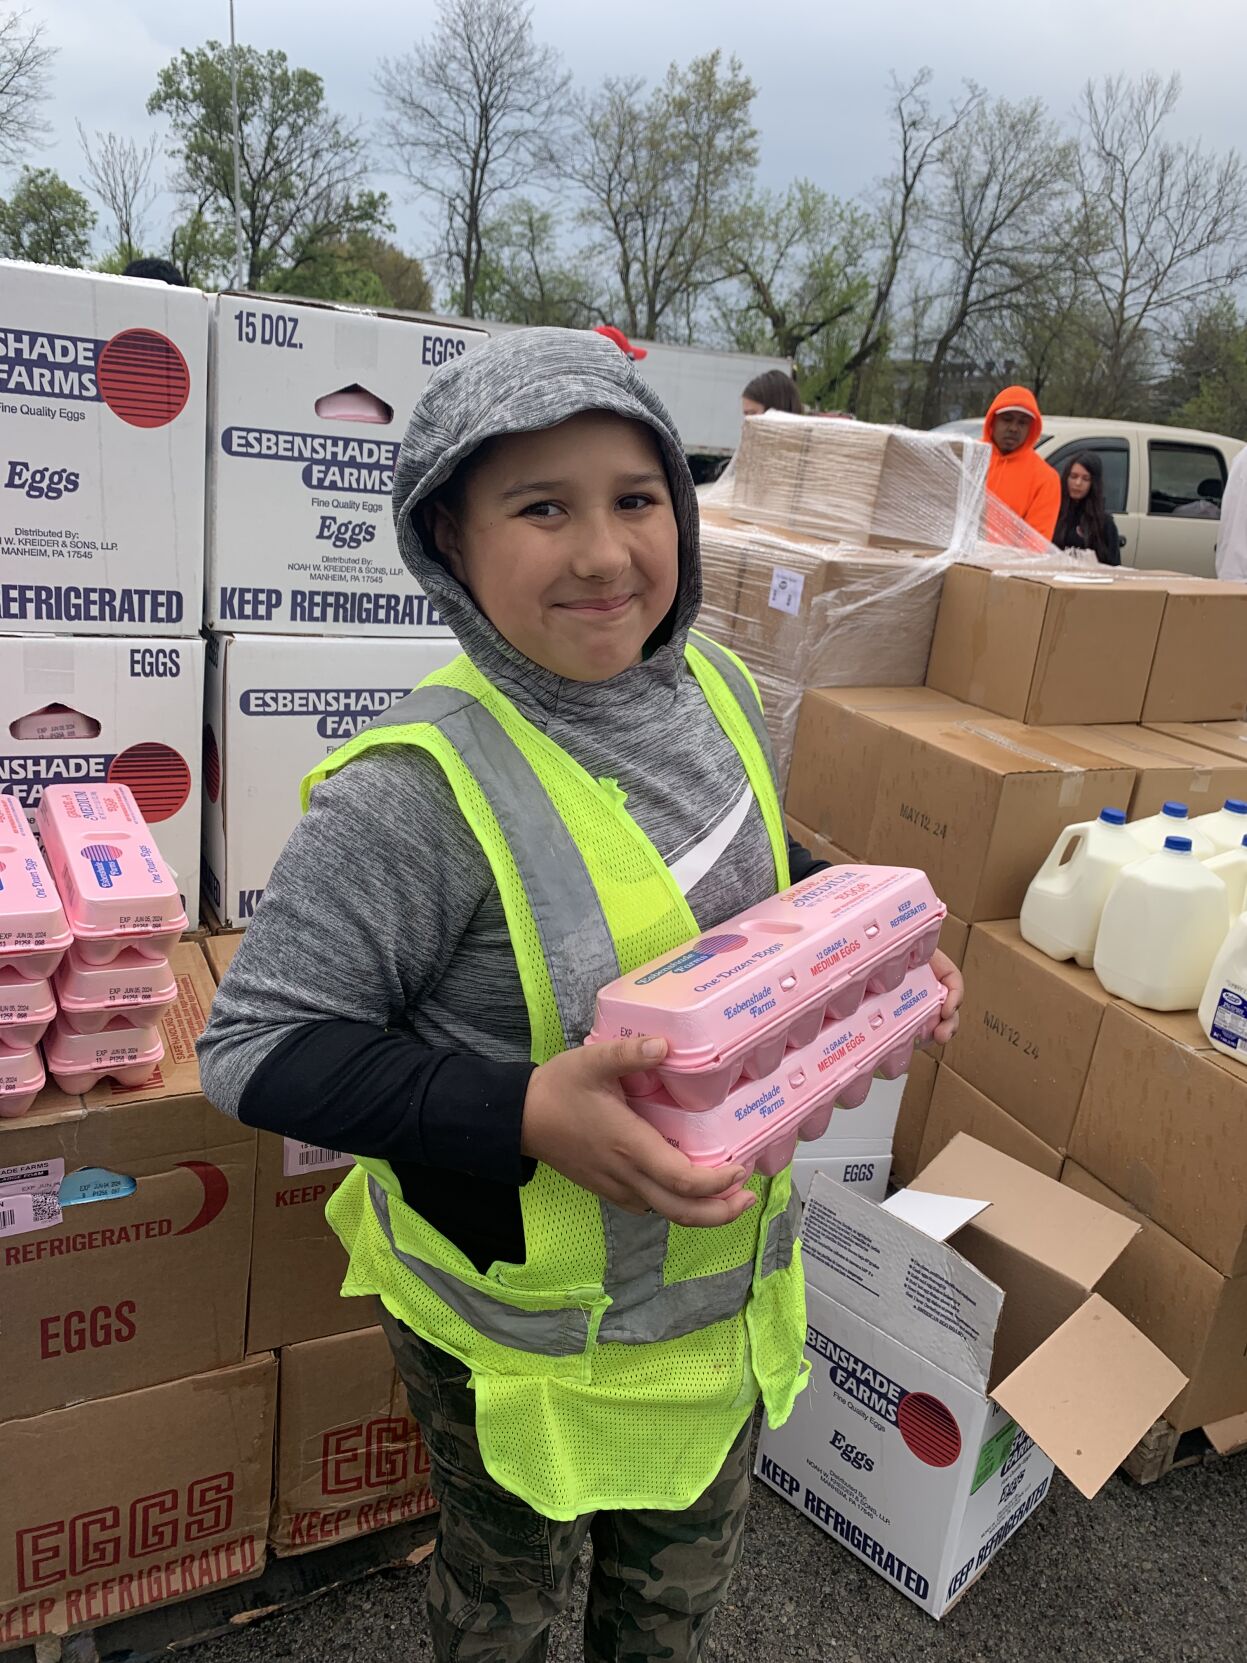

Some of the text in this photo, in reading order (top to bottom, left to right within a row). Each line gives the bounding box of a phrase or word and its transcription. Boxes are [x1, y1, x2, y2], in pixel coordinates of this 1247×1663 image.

[234, 310, 303, 349] 15 DOZ.
[20, 404, 56, 419] Quality
[59, 408, 86, 421] Eggs
[231, 429, 394, 465] ESBENSHADE
[4, 461, 80, 500] Eggs
[311, 465, 393, 491] FARMS
[311, 498, 383, 513] Fine Quality Eggs
[15, 528, 79, 540] Distributed By:
[18, 538, 59, 547] KREIDER
[70, 541, 99, 550] SONS,
[316, 515, 376, 549] Eggs
[1, 547, 93, 559] MANHEIM, PA 17545
[321, 555, 373, 566] Distributed By:
[288, 563, 311, 571] NOAH
[323, 564, 357, 573] KREIDER
[365, 567, 389, 576] SONS,
[309, 573, 349, 583] MANHEIM,
[362, 575, 383, 584] 17545
[0, 584, 183, 623] EFRIGERATED
[220, 587, 449, 626] KEEP REFRIGERATE
[130, 648, 180, 678] EGGS
[139, 845, 152, 858] Eggs
[792, 871, 859, 908] MEDIUM
[890, 902, 927, 928] REFRIGERATED
[897, 900, 912, 913] KEEP
[810, 940, 861, 977] MEDIUM EGGS
[816, 938, 848, 960] 12 GRADE A
[694, 943, 784, 993] One Dozen Eggs
[723, 986, 772, 1020] Esbenshade
[750, 997, 776, 1018] Farms
[893, 989, 928, 1018] REFRIGERATED
[900, 988, 913, 1002] KEEP
[620, 1027, 633, 1038] EXP
[823, 1047, 830, 1056] 12
[830, 1034, 848, 1053] GRADE
[170, 1037, 187, 1061] SAFE
[817, 1033, 866, 1073] MEDIUM EGGS
[735, 1084, 781, 1121] Esbenshade
[760, 1097, 785, 1119] Farms
[21, 1162, 49, 1171] FARMS
[843, 1163, 875, 1183] EGGS
[276, 1185, 326, 1207] KEEP
[5, 1219, 172, 1266] REFRIGERATED
[40, 1301, 137, 1359] EGGS
[835, 1367, 898, 1422] FARMS
[833, 1391, 887, 1433] Fine Quality Eggs
[829, 1429, 875, 1472] Eggs
[16, 1471, 234, 1593] EGGS
[291, 1509, 351, 1549] KEEP
[761, 1454, 800, 1497] KEEP
[804, 1488, 929, 1600] REFRIGERATED
[945, 1557, 975, 1603] KEEP
[975, 1477, 1049, 1570] REFRIGERATED
[0, 1535, 255, 1642] EEP REFRIGERATED
